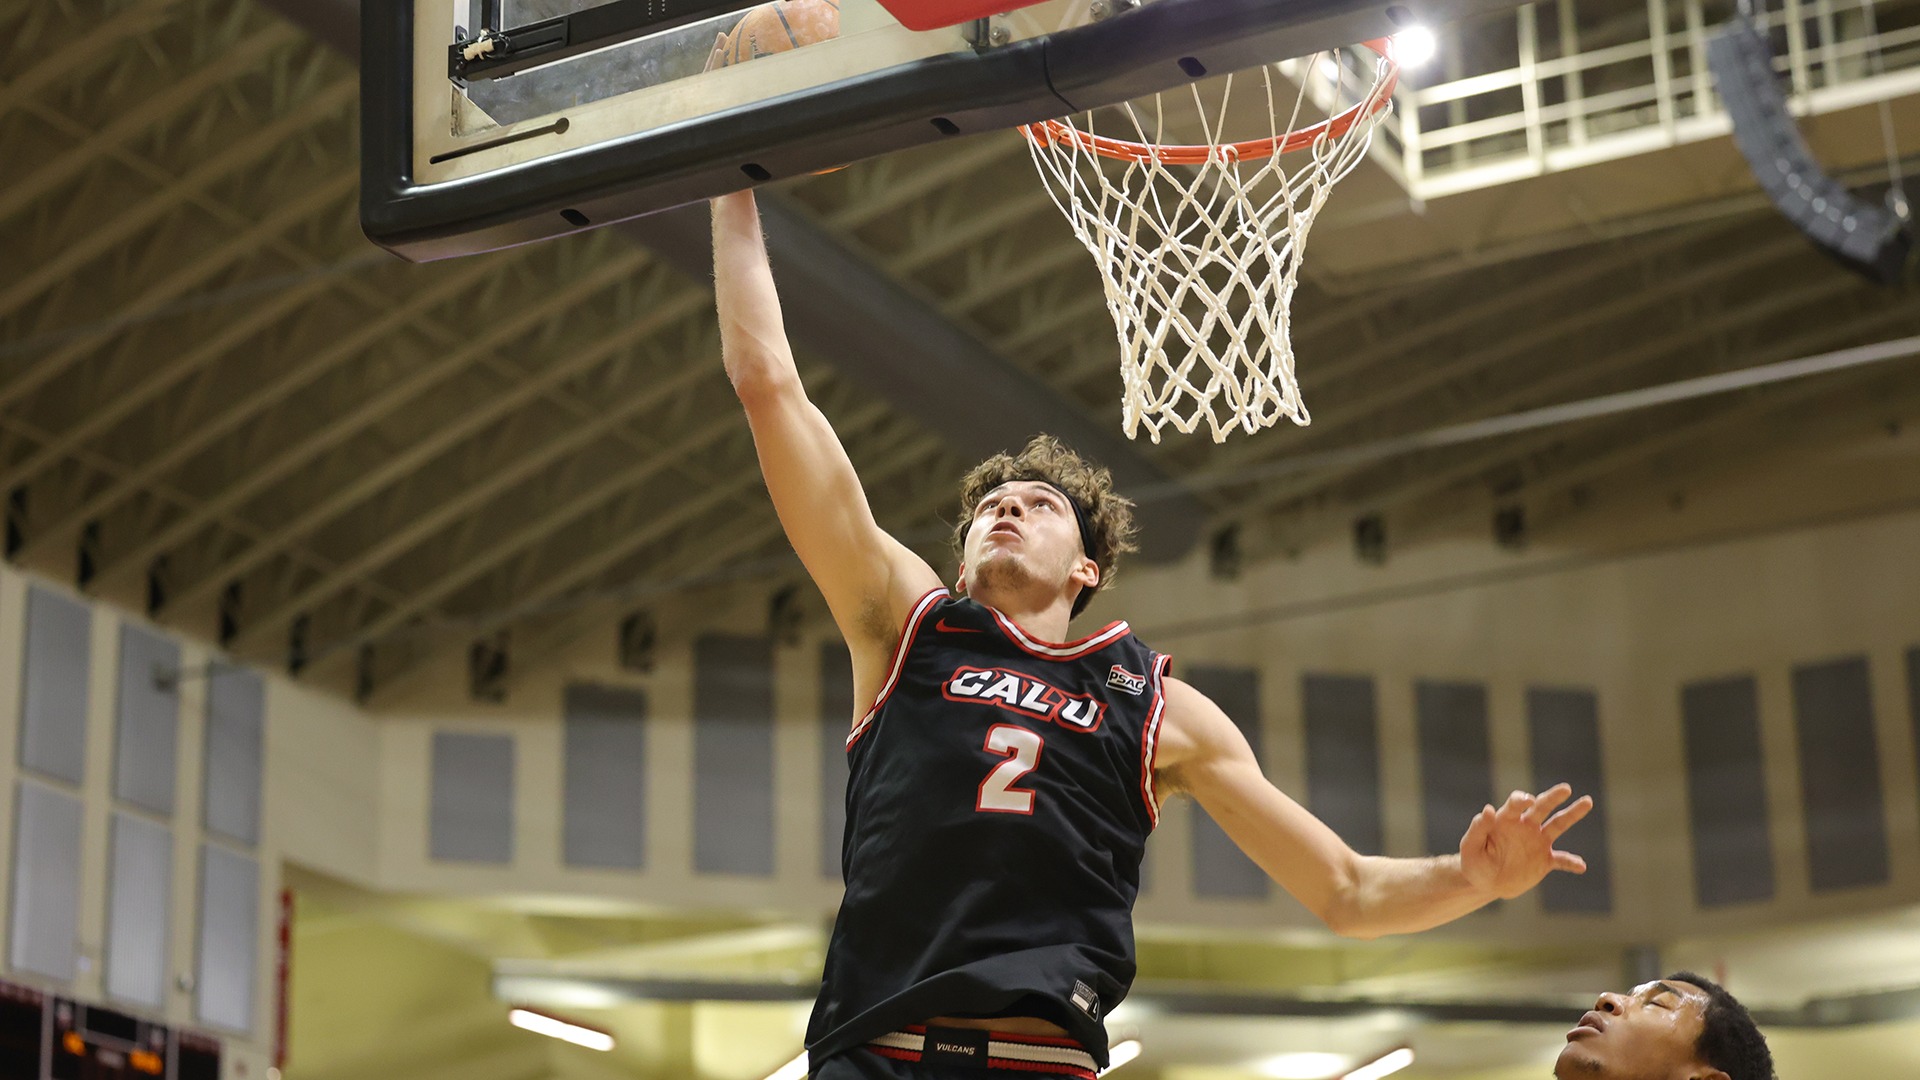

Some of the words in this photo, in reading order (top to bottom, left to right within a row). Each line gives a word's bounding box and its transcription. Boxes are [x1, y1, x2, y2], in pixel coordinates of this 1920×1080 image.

[1109, 670, 1144, 690] PSAC
[978, 725, 1043, 813] 2
[936, 1043, 976, 1056] VULCANS
